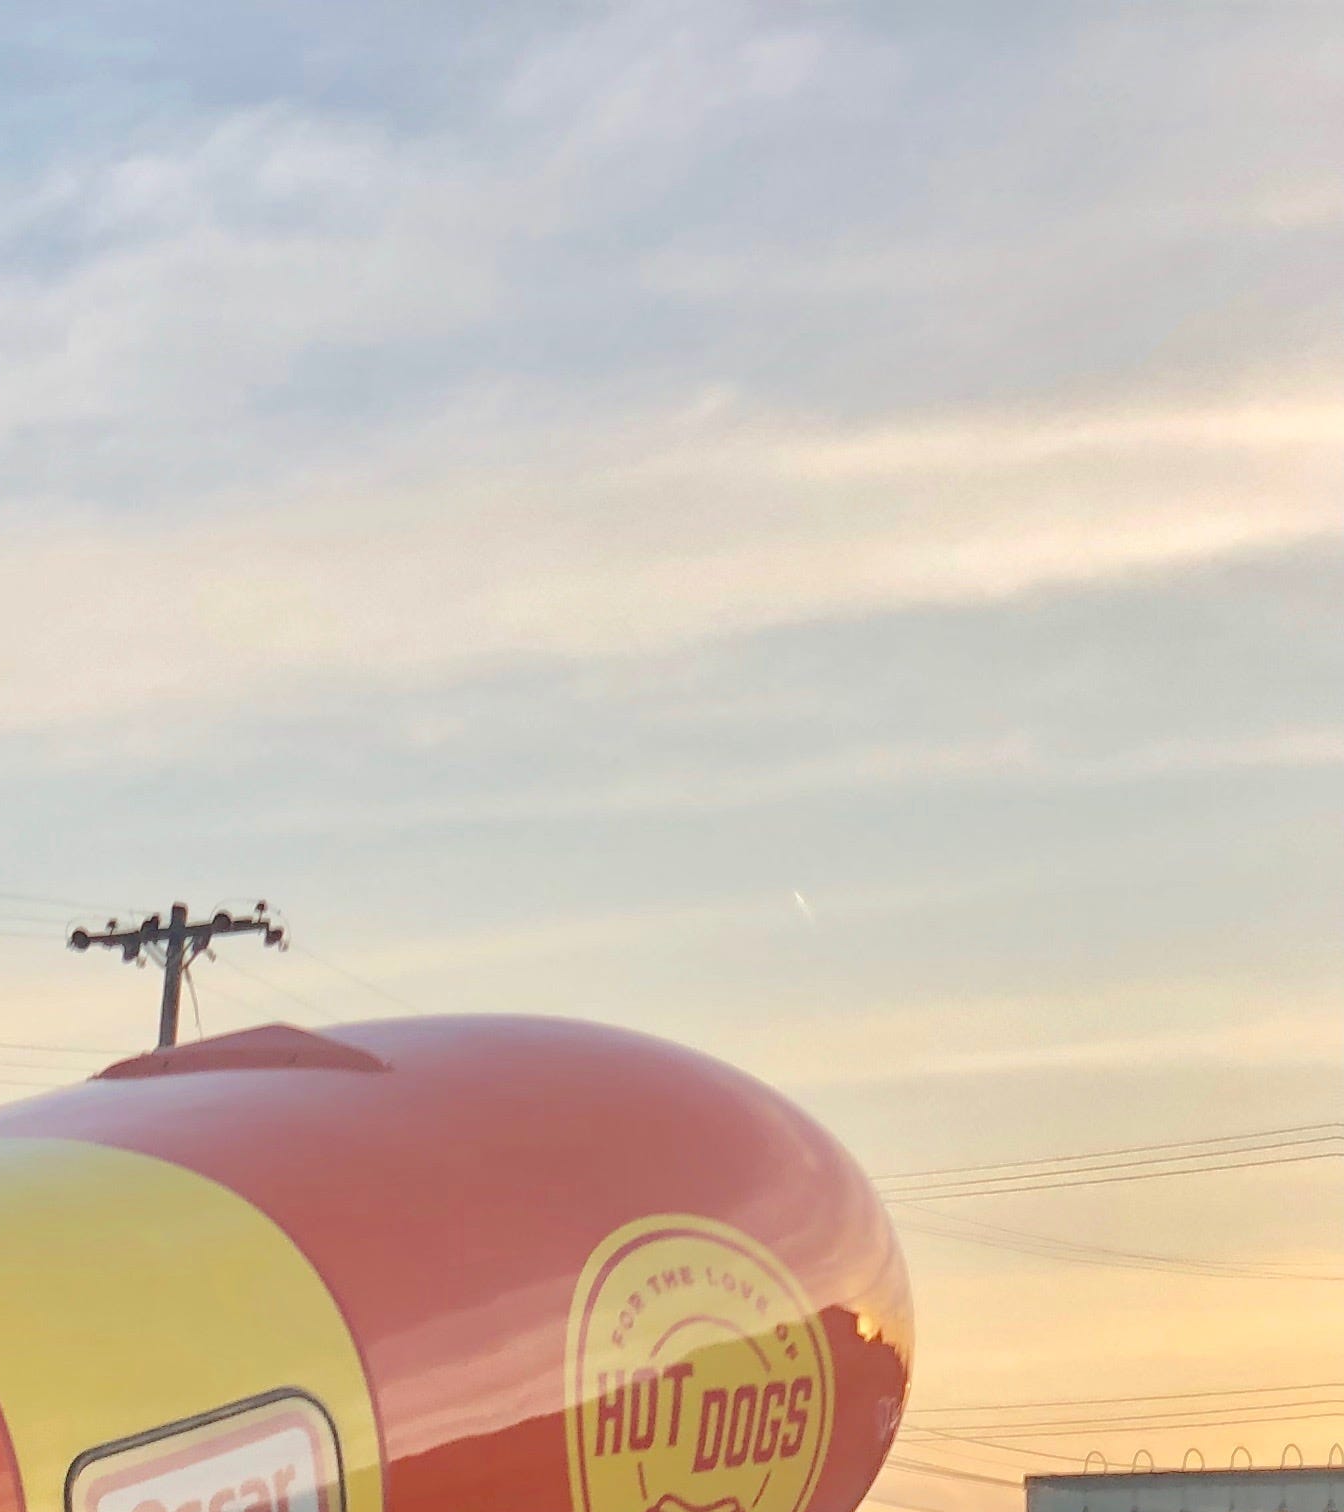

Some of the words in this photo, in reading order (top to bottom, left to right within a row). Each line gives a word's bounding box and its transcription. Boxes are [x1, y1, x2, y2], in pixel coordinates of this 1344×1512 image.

[612, 1291, 646, 1349] FOR
[646, 1265, 695, 1296] THE
[705, 1266, 769, 1317] LOVE
[774, 1320, 800, 1361] OF
[594, 1362, 694, 1458] HOT
[691, 1376, 813, 1474] DOGS
